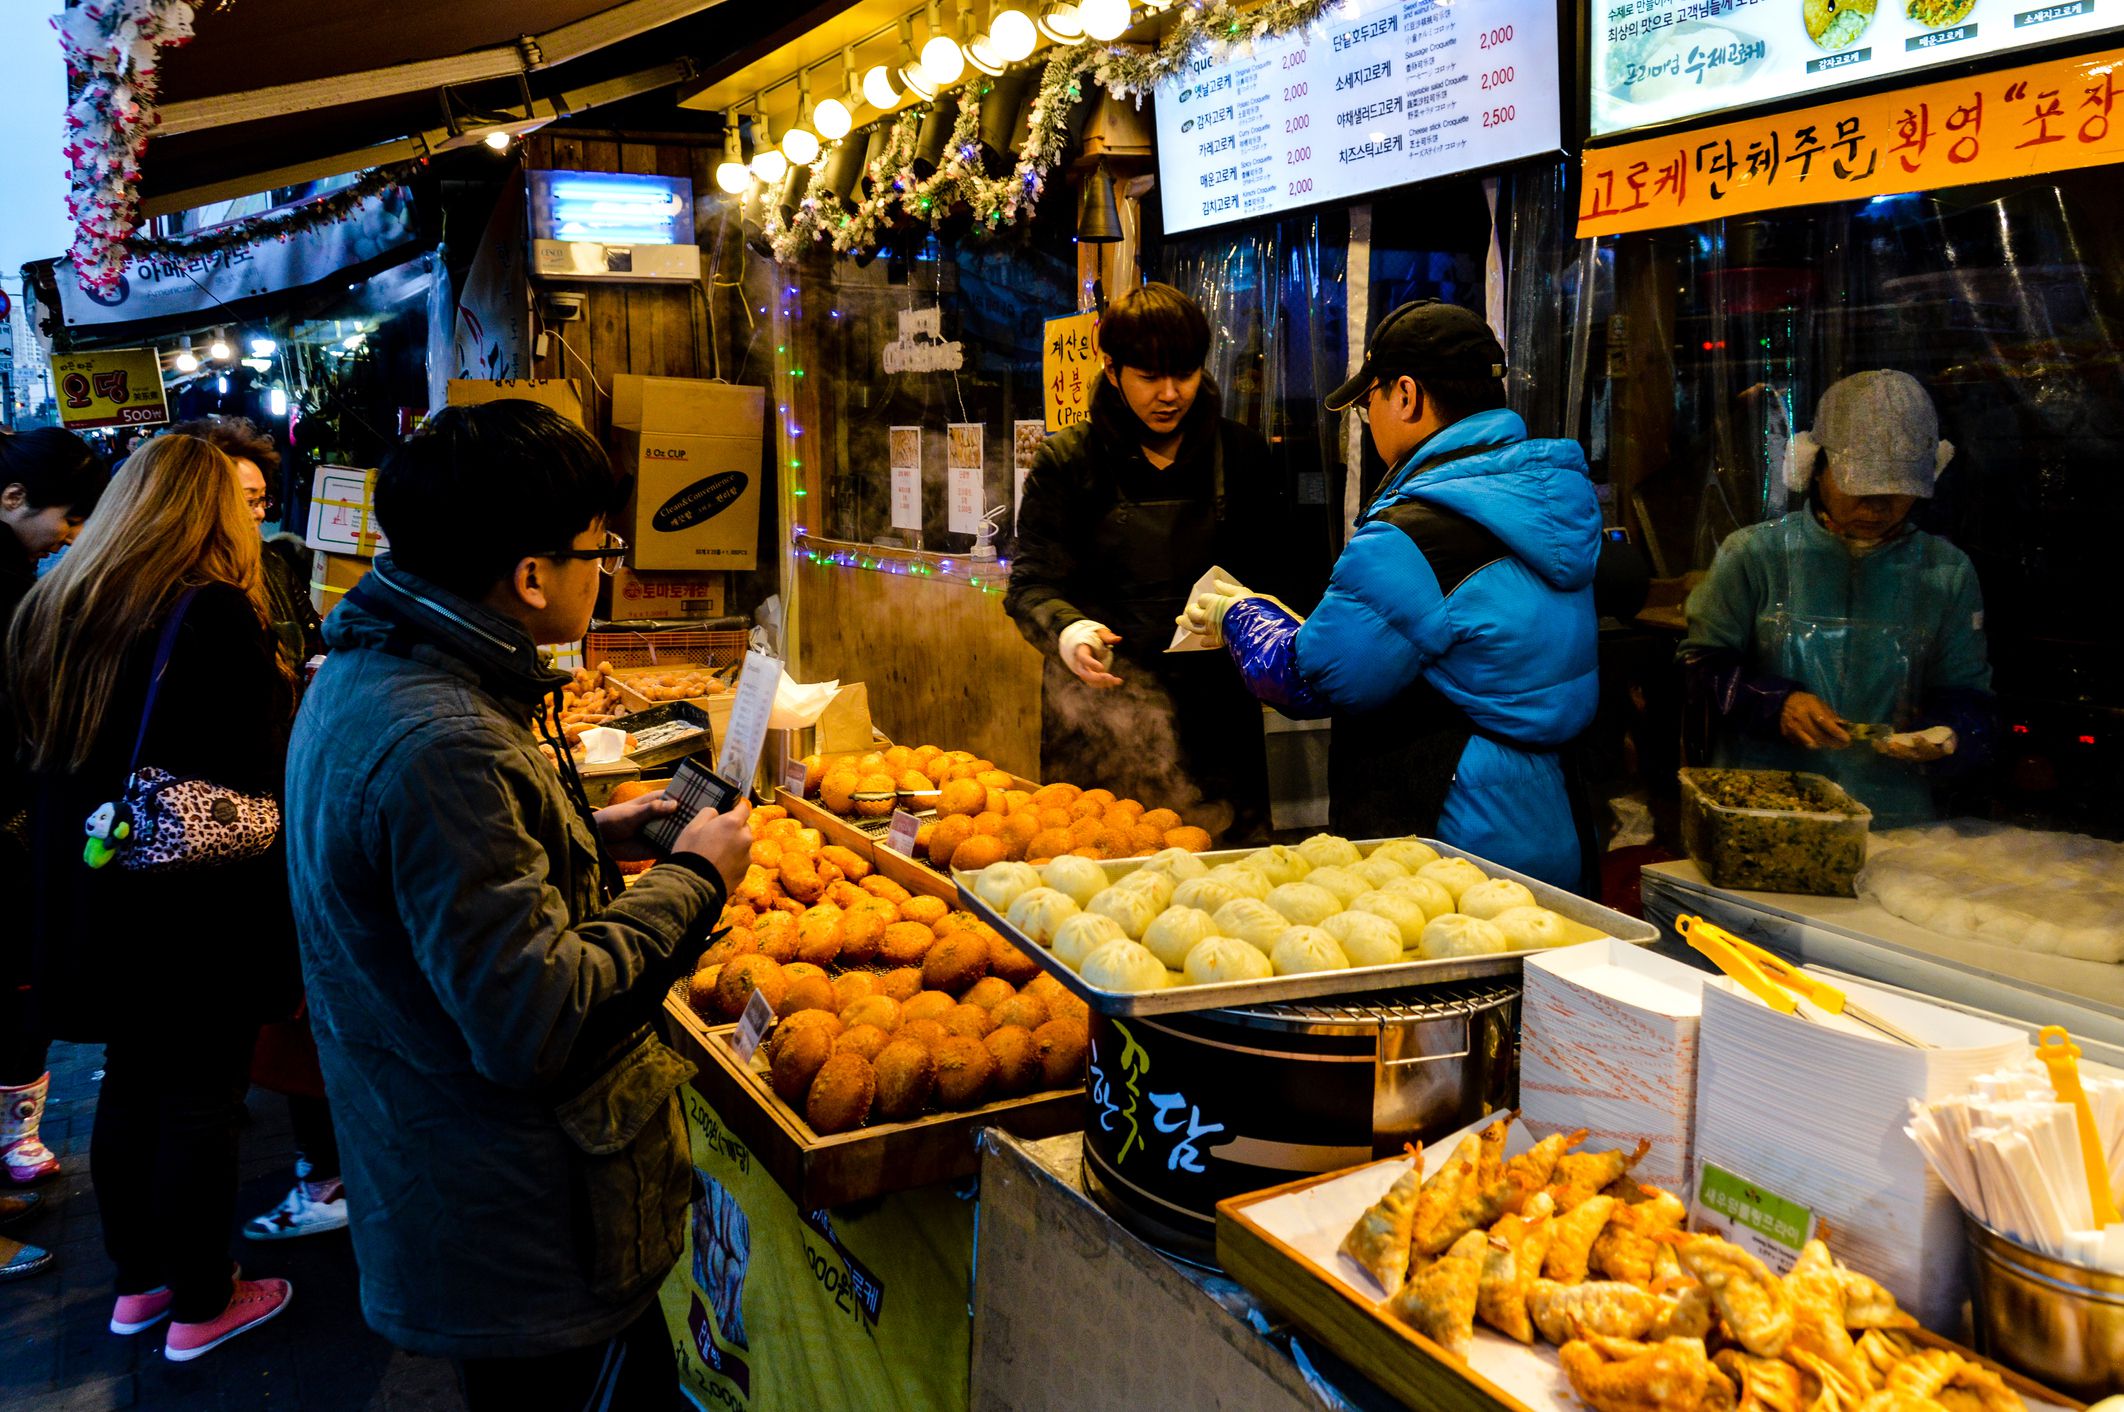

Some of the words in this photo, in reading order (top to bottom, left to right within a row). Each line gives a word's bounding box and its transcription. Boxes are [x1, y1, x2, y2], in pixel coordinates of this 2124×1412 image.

[1480, 25, 1513, 50] 2,000
[1608, 21, 1639, 42] 최상의
[1641, 12, 1673, 35] 맛으로
[1282, 49, 1307, 70] 2,000
[1335, 60, 1392, 91] 소세지고로케
[1481, 66, 1514, 91] 2,000
[1284, 82, 1308, 102] 2,000
[1196, 105, 1233, 130] 감자고로케
[1285, 114, 1309, 134] 2,000
[1337, 96, 1402, 128] 야채샐러드고로케
[1483, 105, 1515, 129] 2,500
[1199, 135, 1235, 157] 카레고로케
[1288, 146, 1311, 165] 2,000
[1578, 150, 1687, 222] 고로케
[1889, 91, 1984, 174] 환영
[1200, 166, 1237, 188] 매운고로케
[1289, 178, 1313, 197] 2,000
[1202, 194, 1239, 216] 김치고로케
[1051, 329, 1088, 363] 계산은
[1051, 367, 1082, 405] 선불
[645, 448, 651, 457] 8
[654, 449, 665, 457] Oz
[667, 450, 686, 459] CUP
[660, 474, 735, 517] Clean&Convenience
